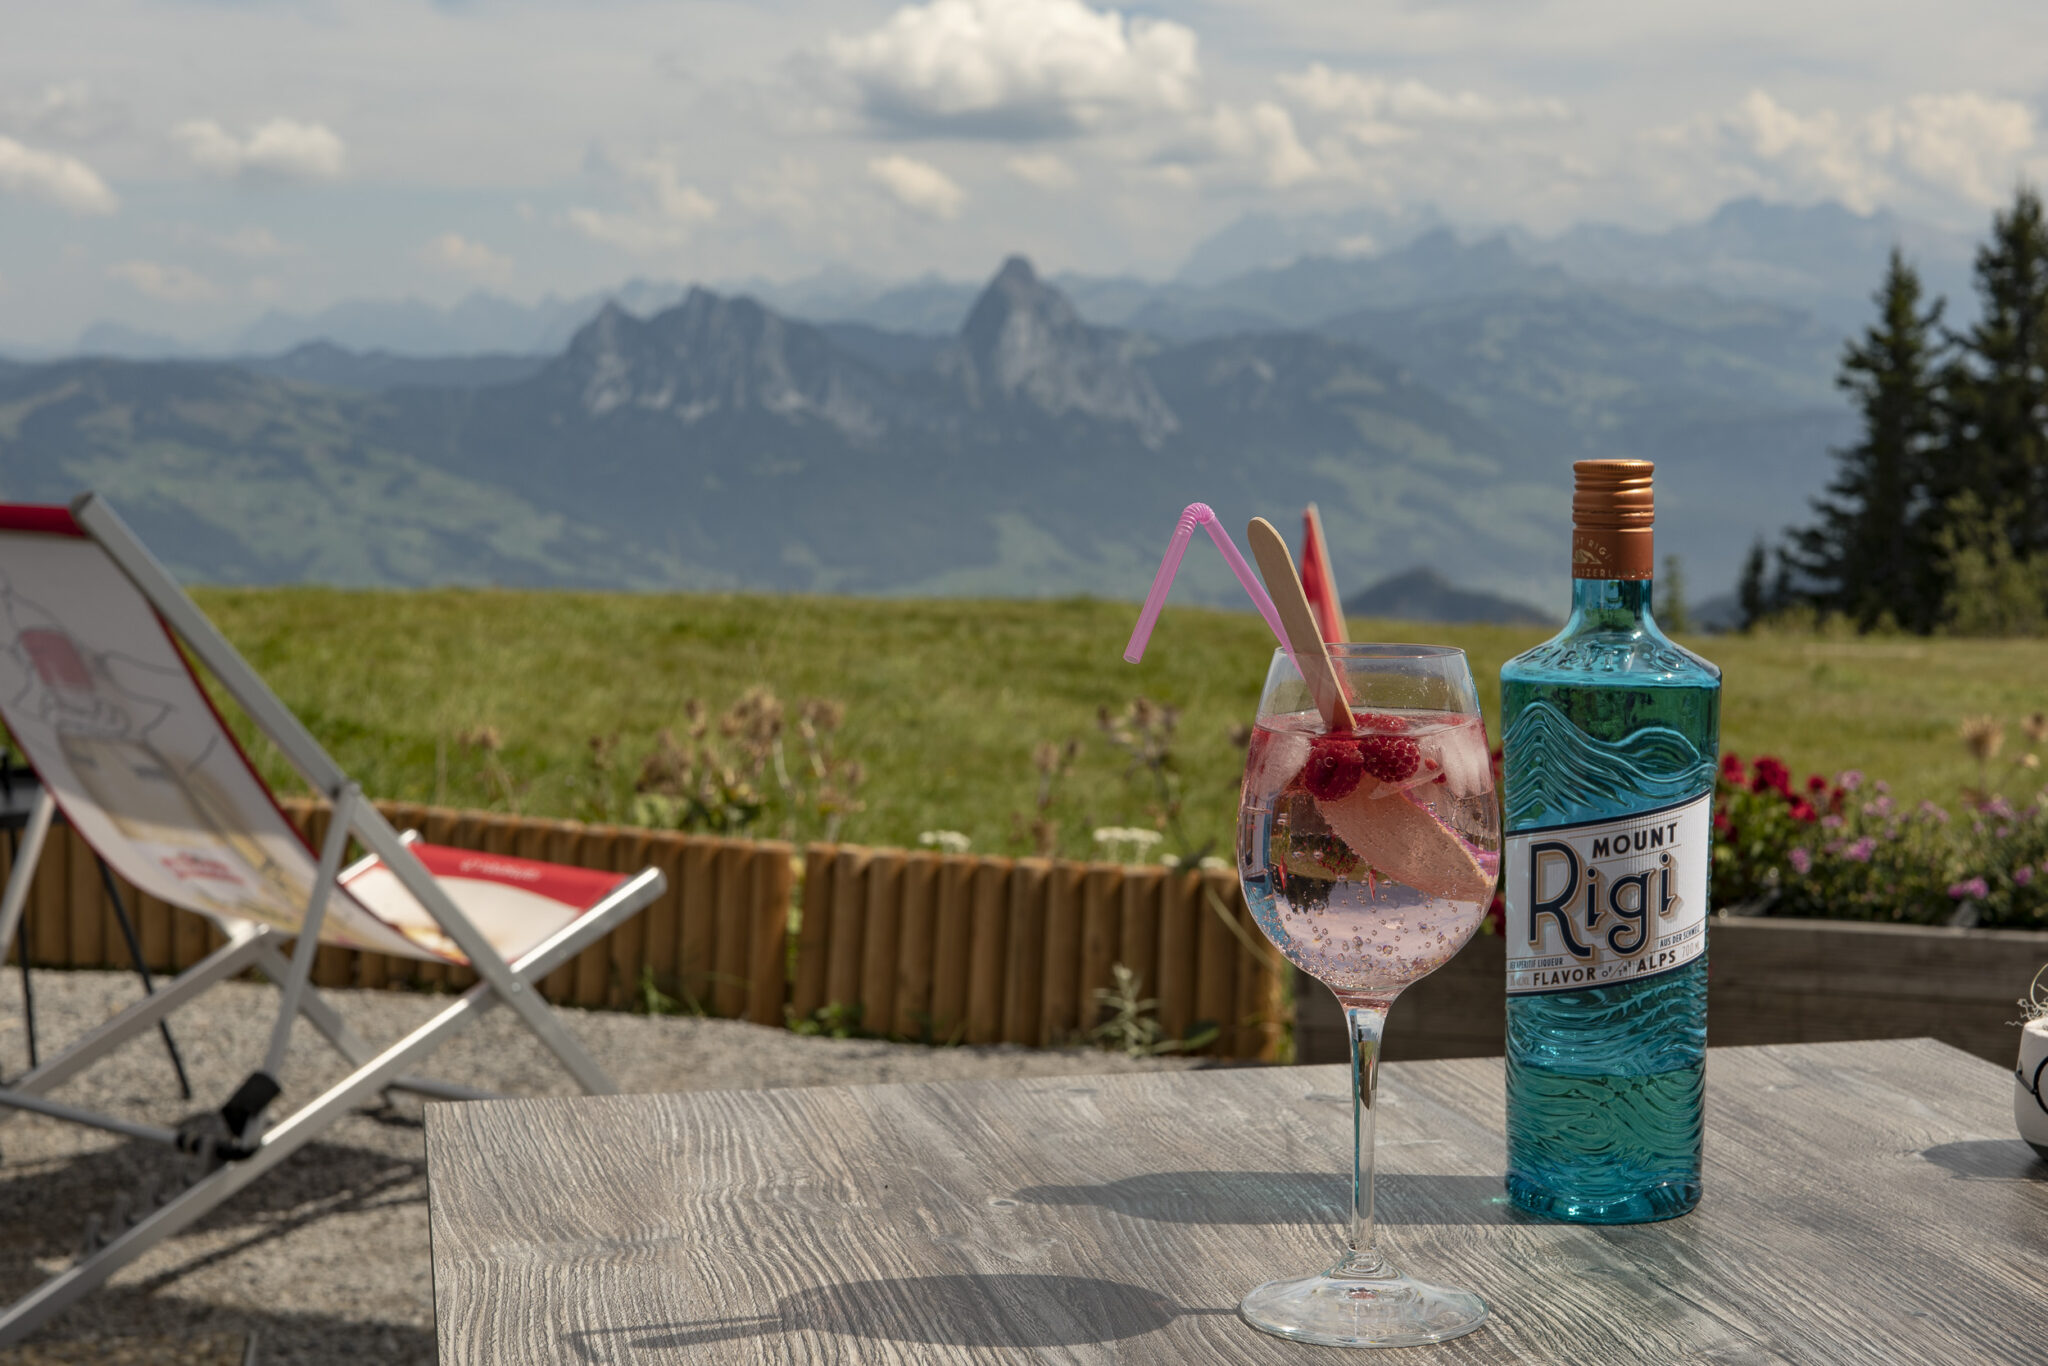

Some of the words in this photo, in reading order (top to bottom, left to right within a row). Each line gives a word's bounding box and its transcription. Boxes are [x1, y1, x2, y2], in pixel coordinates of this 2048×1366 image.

[1592, 822, 1678, 858] MOUNT
[1528, 839, 1680, 961] Rigi
[1660, 936, 1671, 948] AUS
[1672, 932, 1683, 944] DER
[1533, 967, 1596, 986] FLAVOR
[1637, 950, 1676, 973] ALPS
[1537, 957, 1563, 968] LIQUEUR
